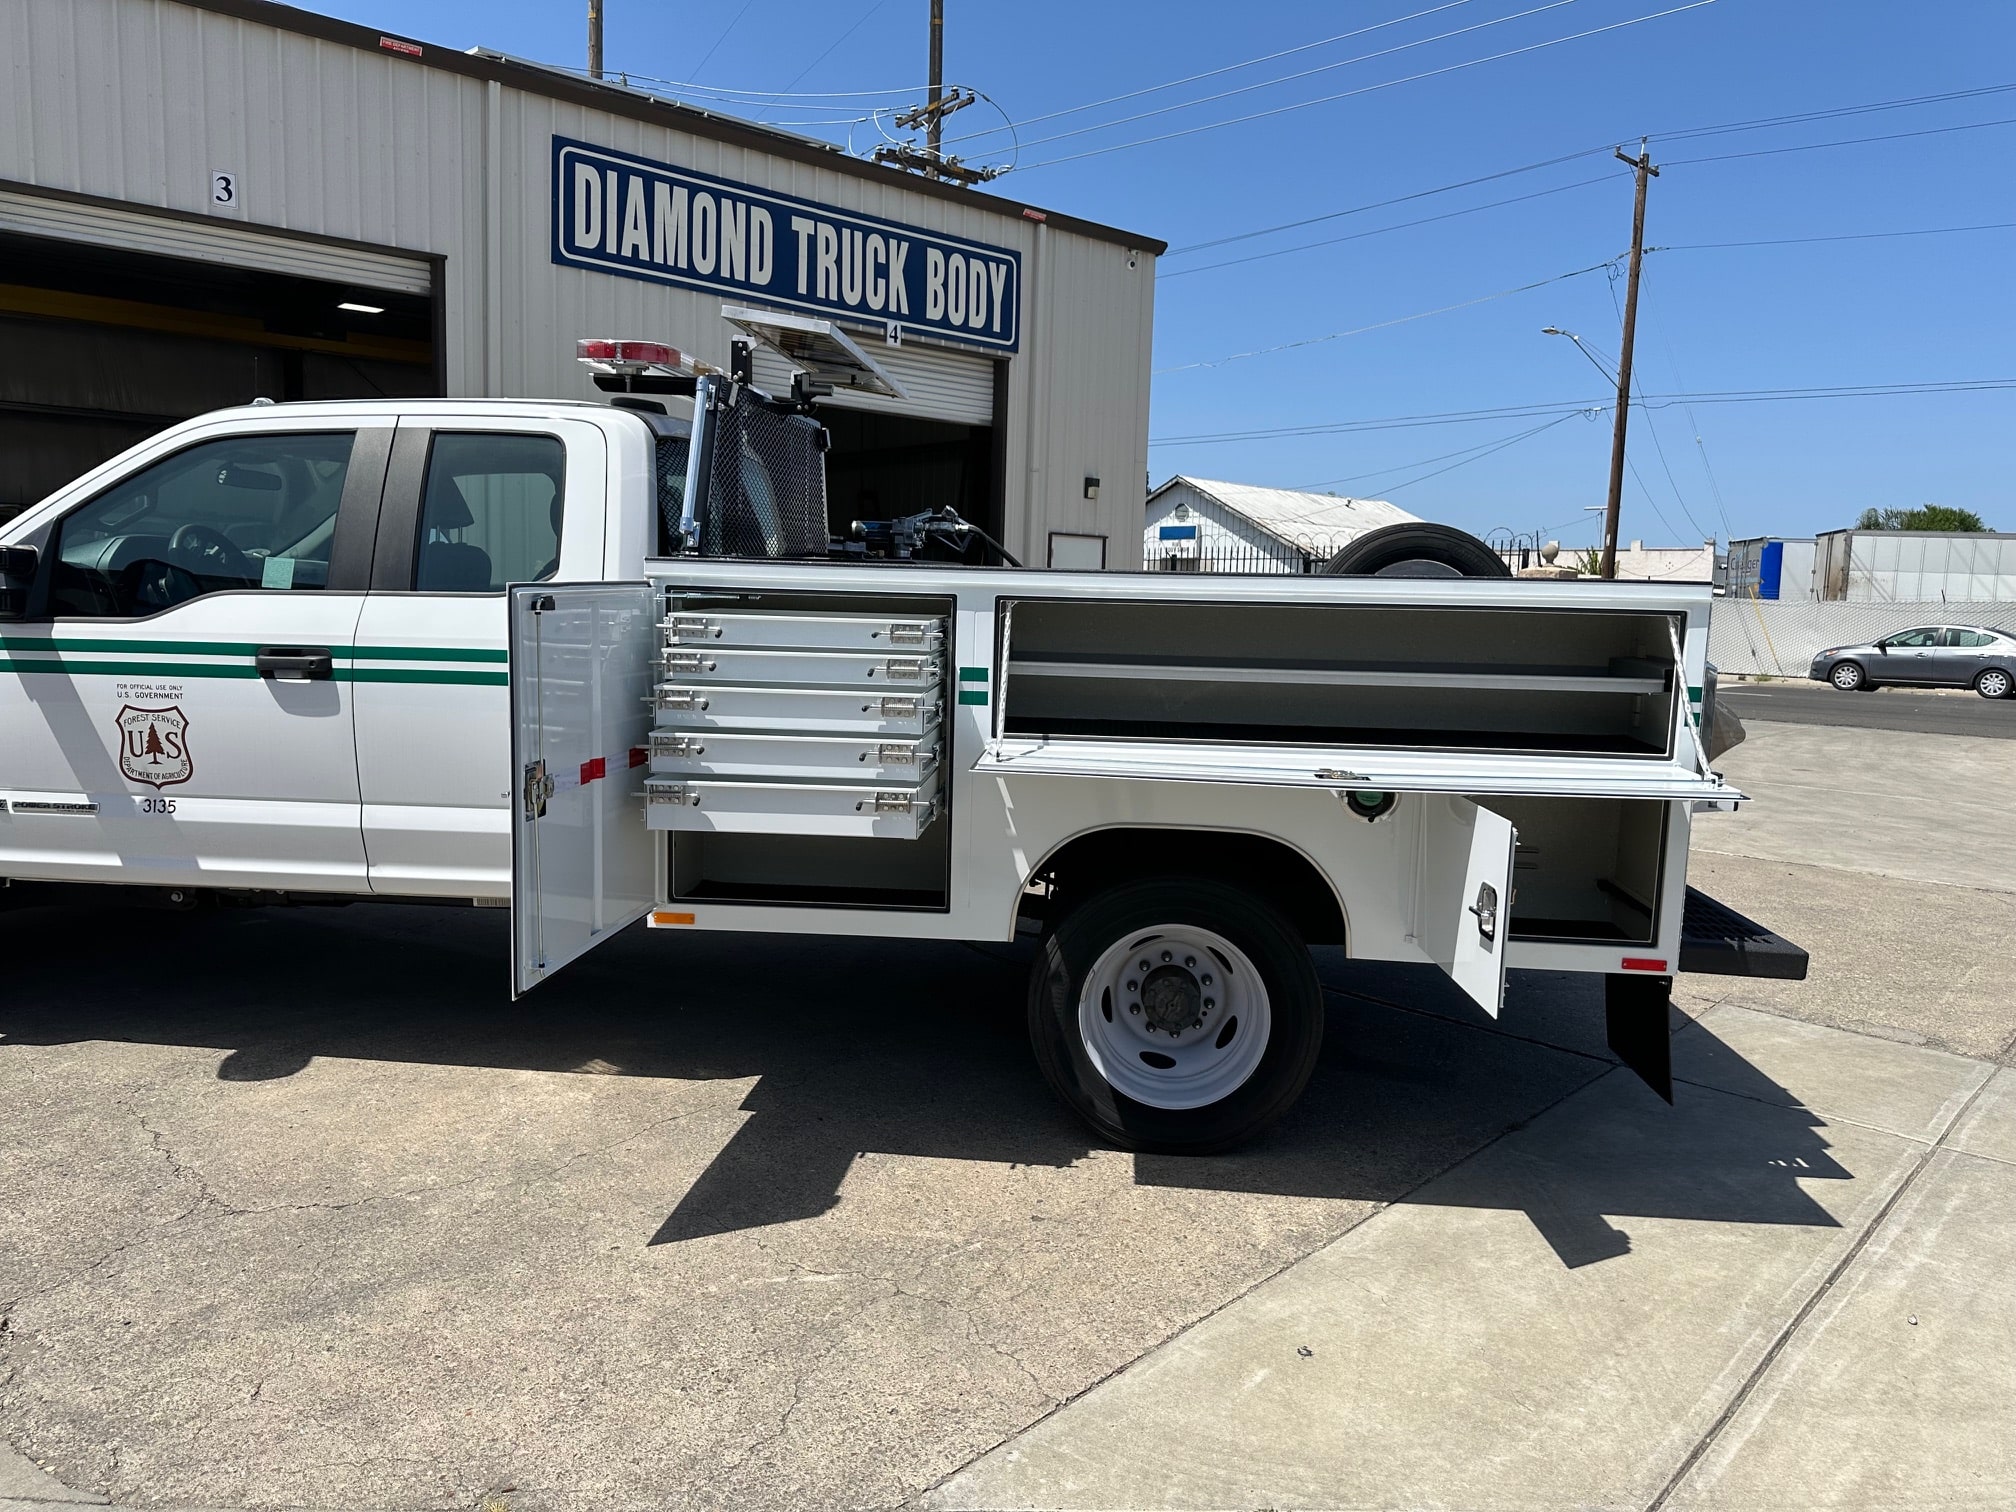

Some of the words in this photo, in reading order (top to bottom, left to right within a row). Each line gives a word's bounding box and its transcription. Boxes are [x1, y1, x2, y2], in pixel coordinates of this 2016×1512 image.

[215, 176, 233, 202] 3
[574, 162, 773, 286] DIAMOND
[791, 215, 909, 315] TRUCK
[926, 248, 1007, 332] BODY
[889, 325, 899, 344] 4
[116, 691, 132, 699] U.S.
[134, 691, 184, 700] GOVERNMENT
[123, 713, 150, 728] FOREST
[151, 713, 181, 730] SERVICE
[127, 730, 144, 758] U
[165, 731, 182, 759] S
[123, 756, 154, 780] DEPARTMENT
[154, 771, 161, 780] OF
[161, 758, 188, 780] AGRICULTURE
[142, 798, 177, 814] 3135
